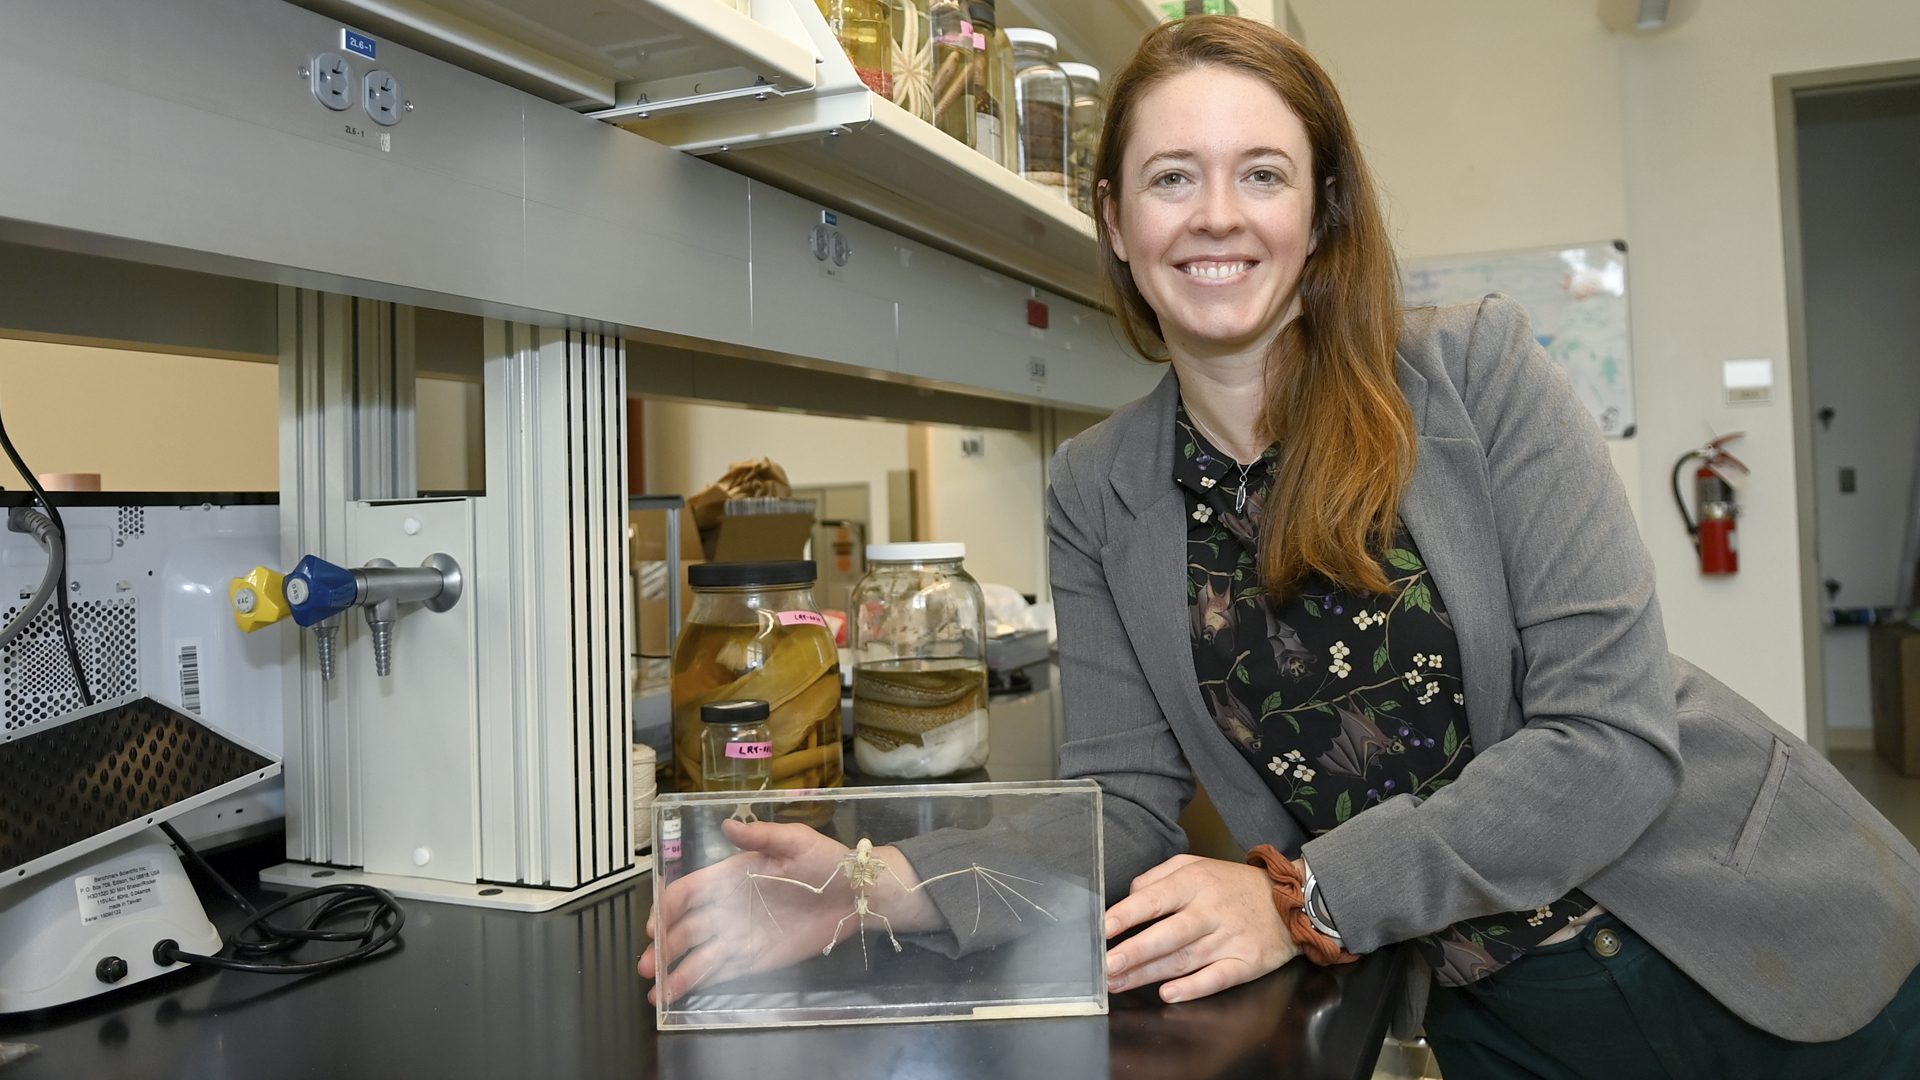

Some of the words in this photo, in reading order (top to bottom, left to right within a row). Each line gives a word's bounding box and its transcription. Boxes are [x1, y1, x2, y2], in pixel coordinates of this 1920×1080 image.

[350, 37, 372, 52] 2L6-1
[237, 597, 249, 605] VAC
[94, 873, 118, 882] Benchmark
[119, 868, 138, 876] Scientific
